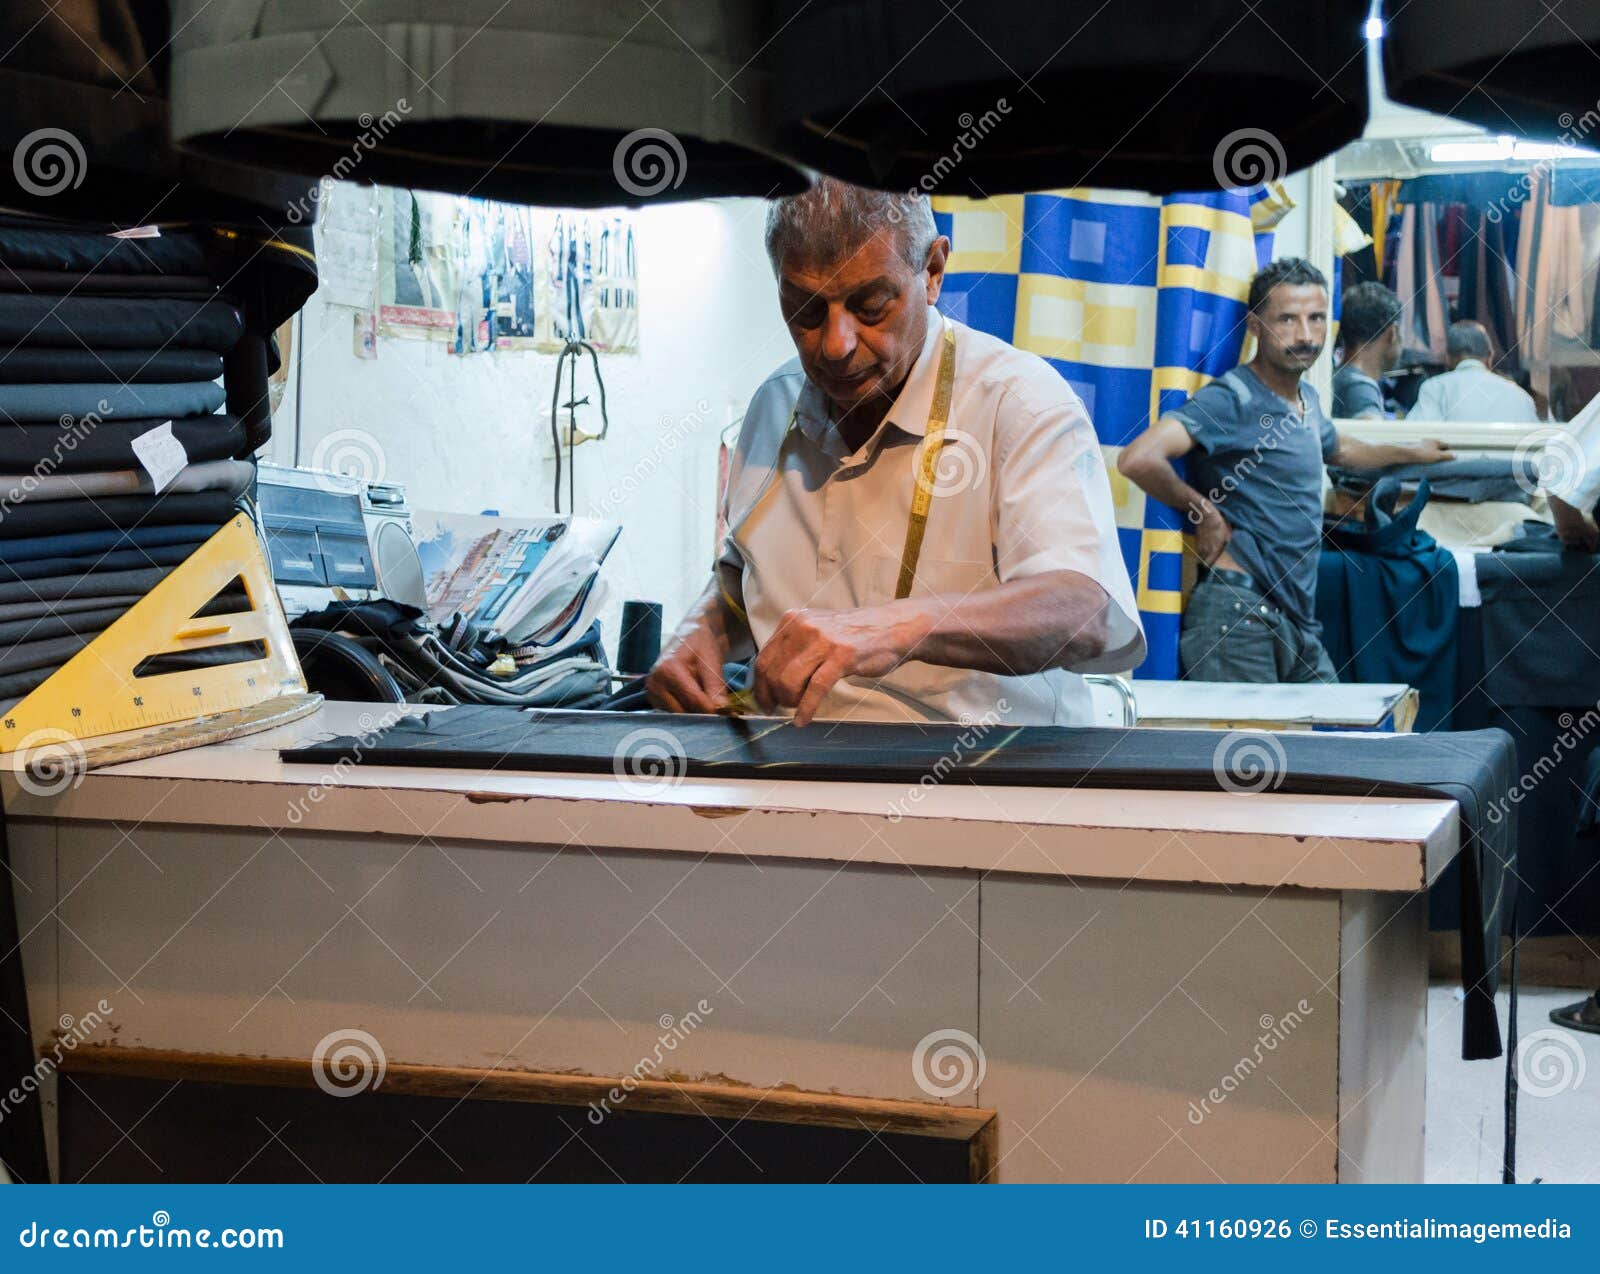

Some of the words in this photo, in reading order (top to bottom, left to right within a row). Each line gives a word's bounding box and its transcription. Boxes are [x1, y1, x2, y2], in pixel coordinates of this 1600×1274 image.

[192, 686, 202, 696] 20
[133, 696, 144, 706] 30
[71, 707, 82, 718] 40
[4, 718, 16, 729] 50
